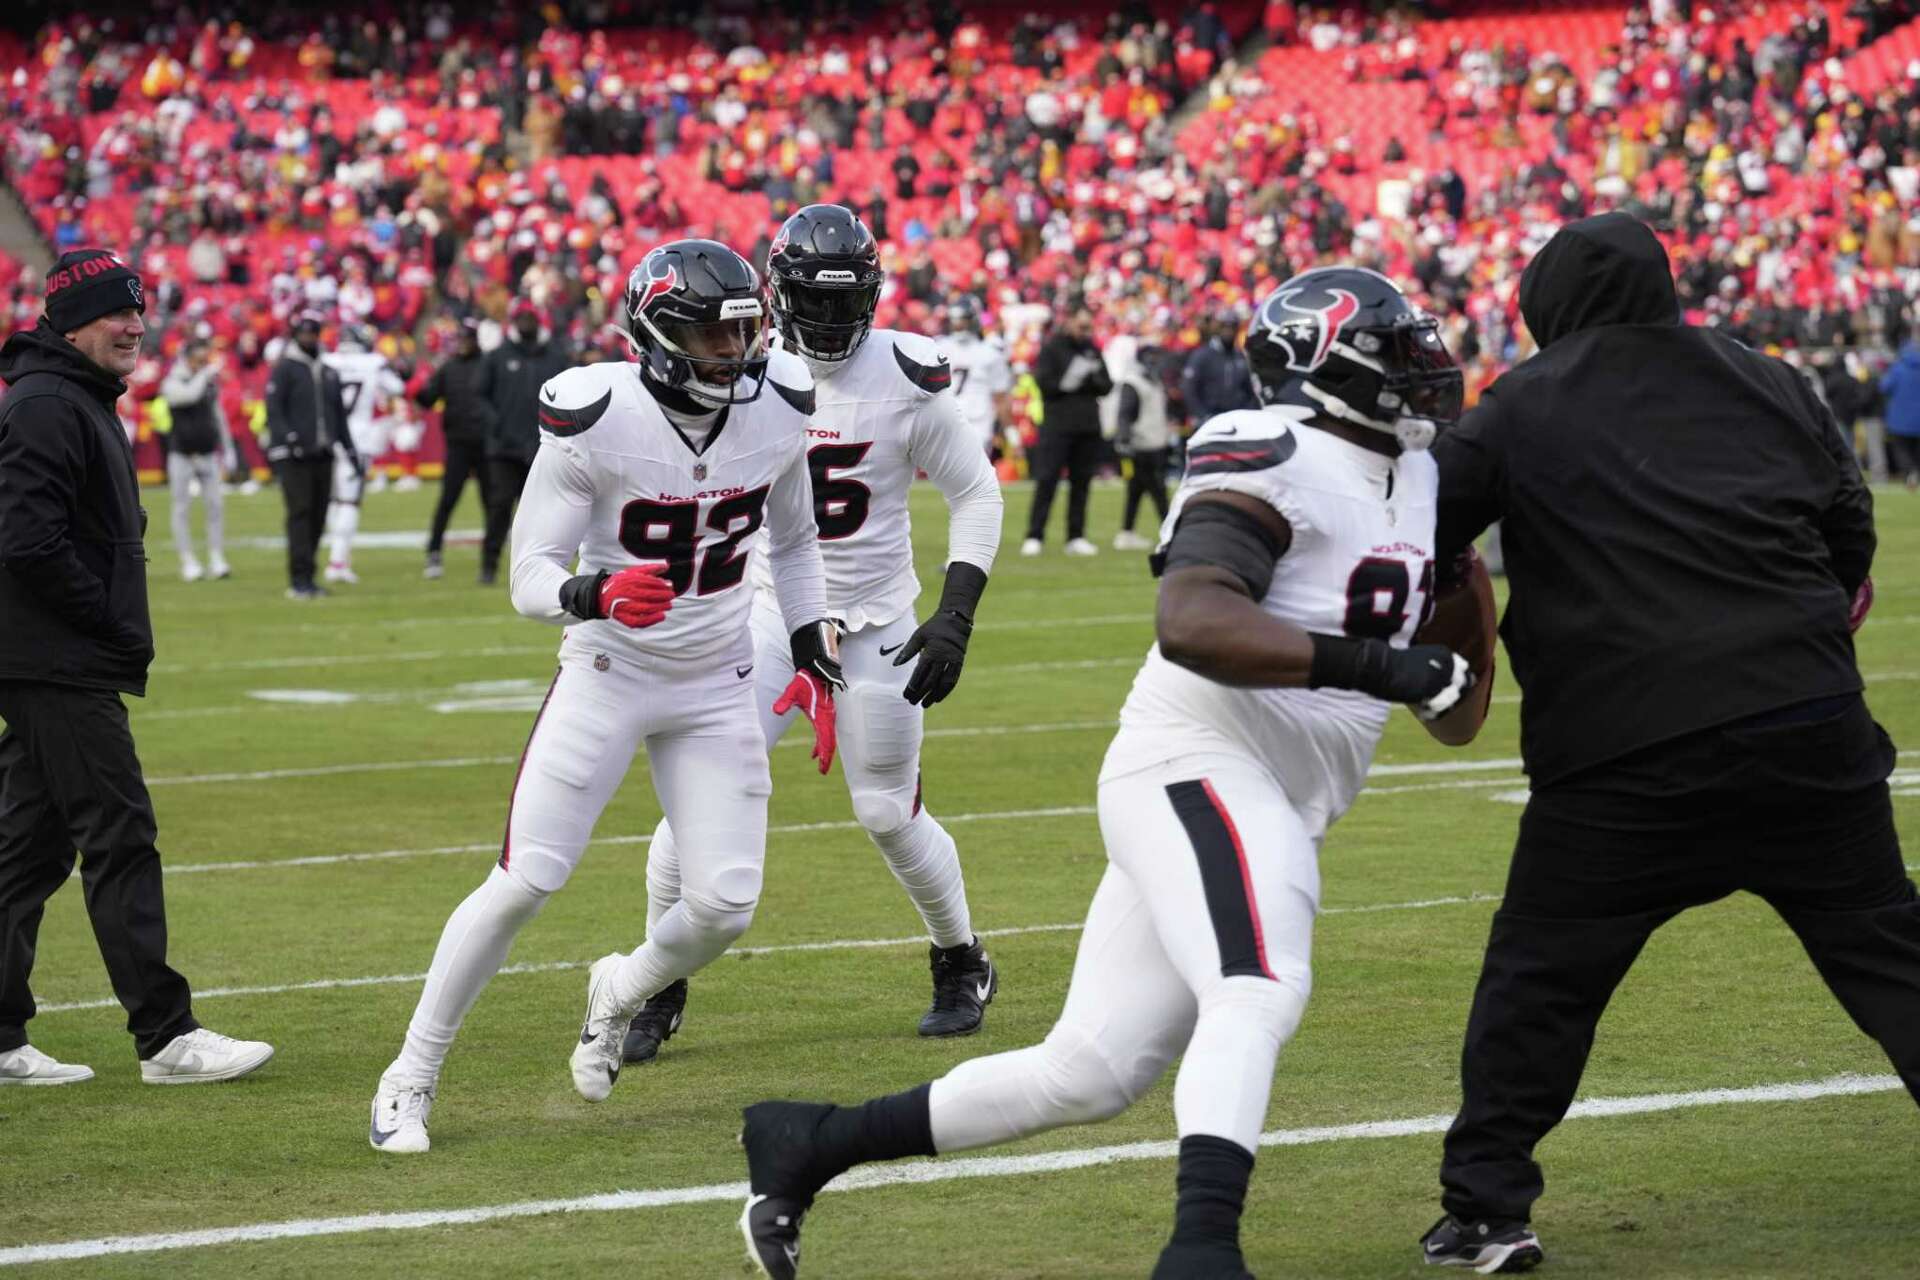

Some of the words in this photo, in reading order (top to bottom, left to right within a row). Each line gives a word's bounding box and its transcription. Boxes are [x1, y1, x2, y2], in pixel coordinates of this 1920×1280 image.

[44, 256, 116, 297] USTON
[806, 429, 841, 439] TON
[807, 441, 874, 540] 6
[618, 483, 771, 597] 92
